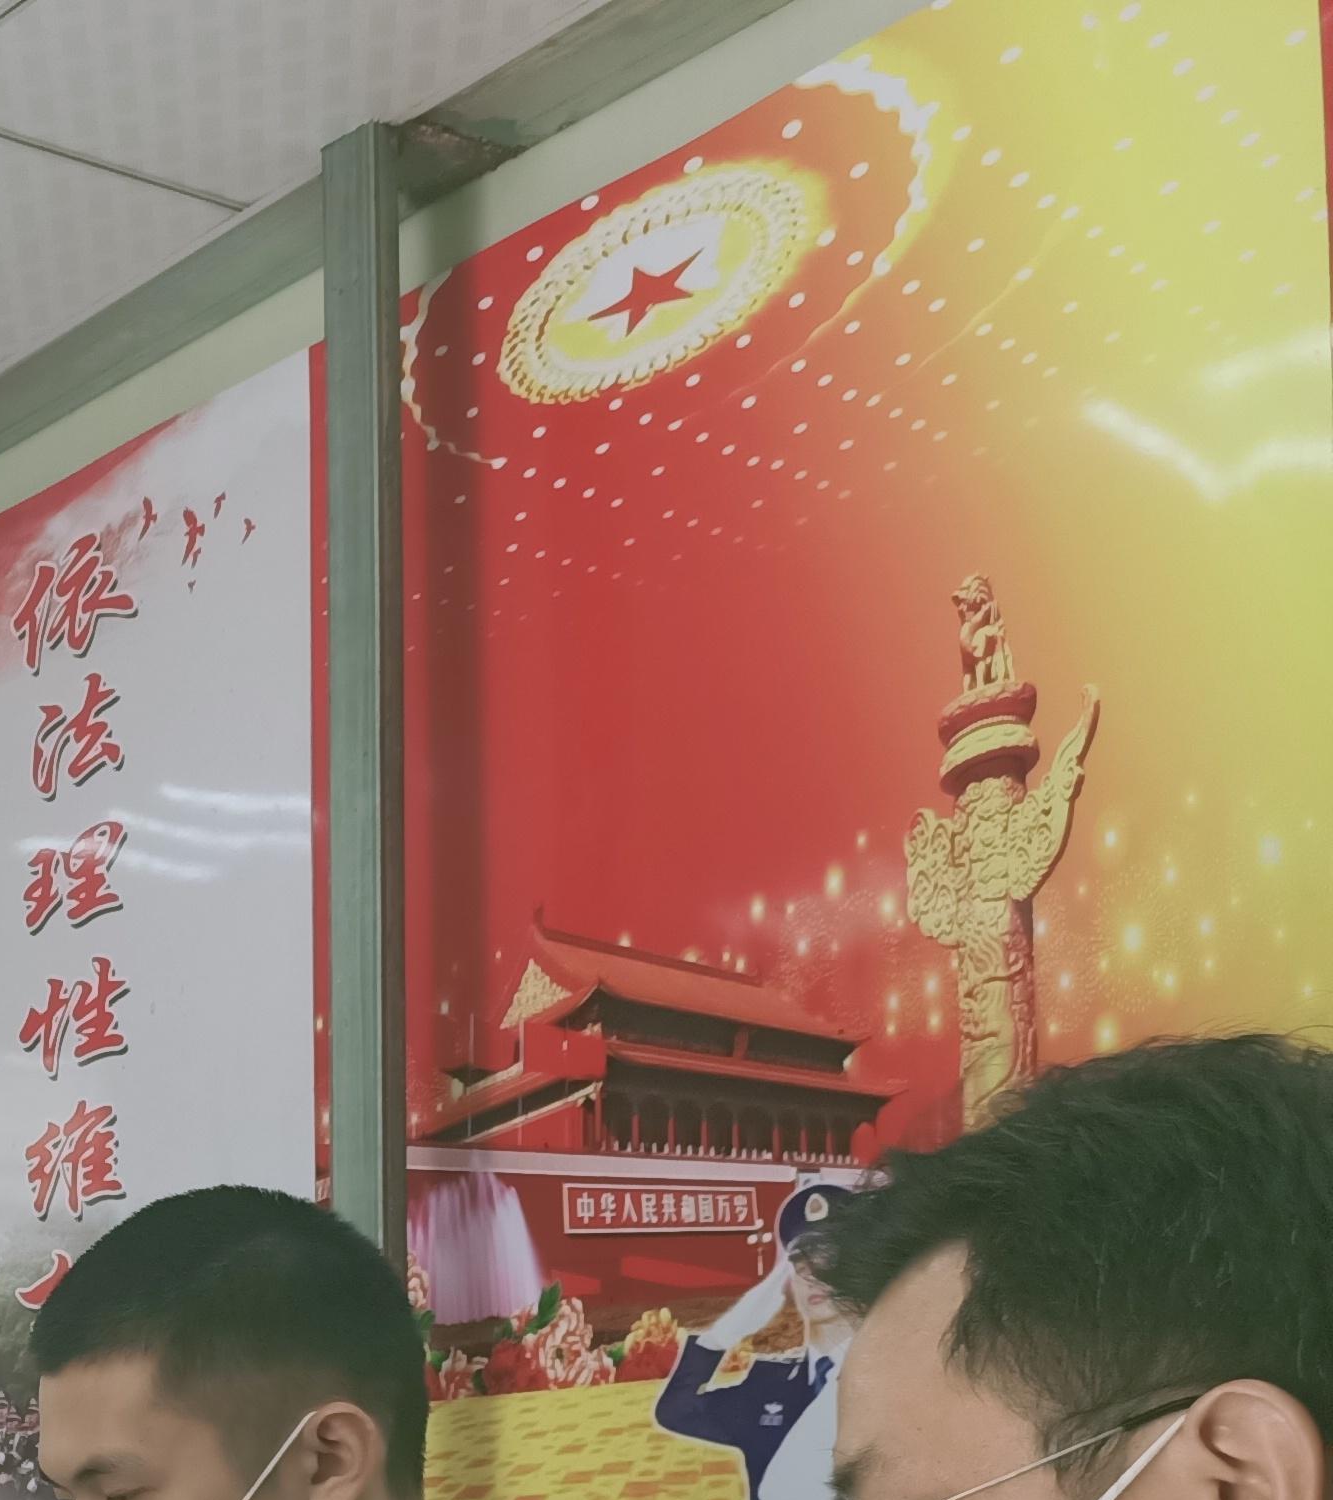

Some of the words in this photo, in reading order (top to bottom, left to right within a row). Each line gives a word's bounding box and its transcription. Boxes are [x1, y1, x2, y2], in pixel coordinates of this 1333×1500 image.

[14, 533, 136, 1312] 依法理性维
[576, 1191, 748, 1224] 中华人民共和国万岁
